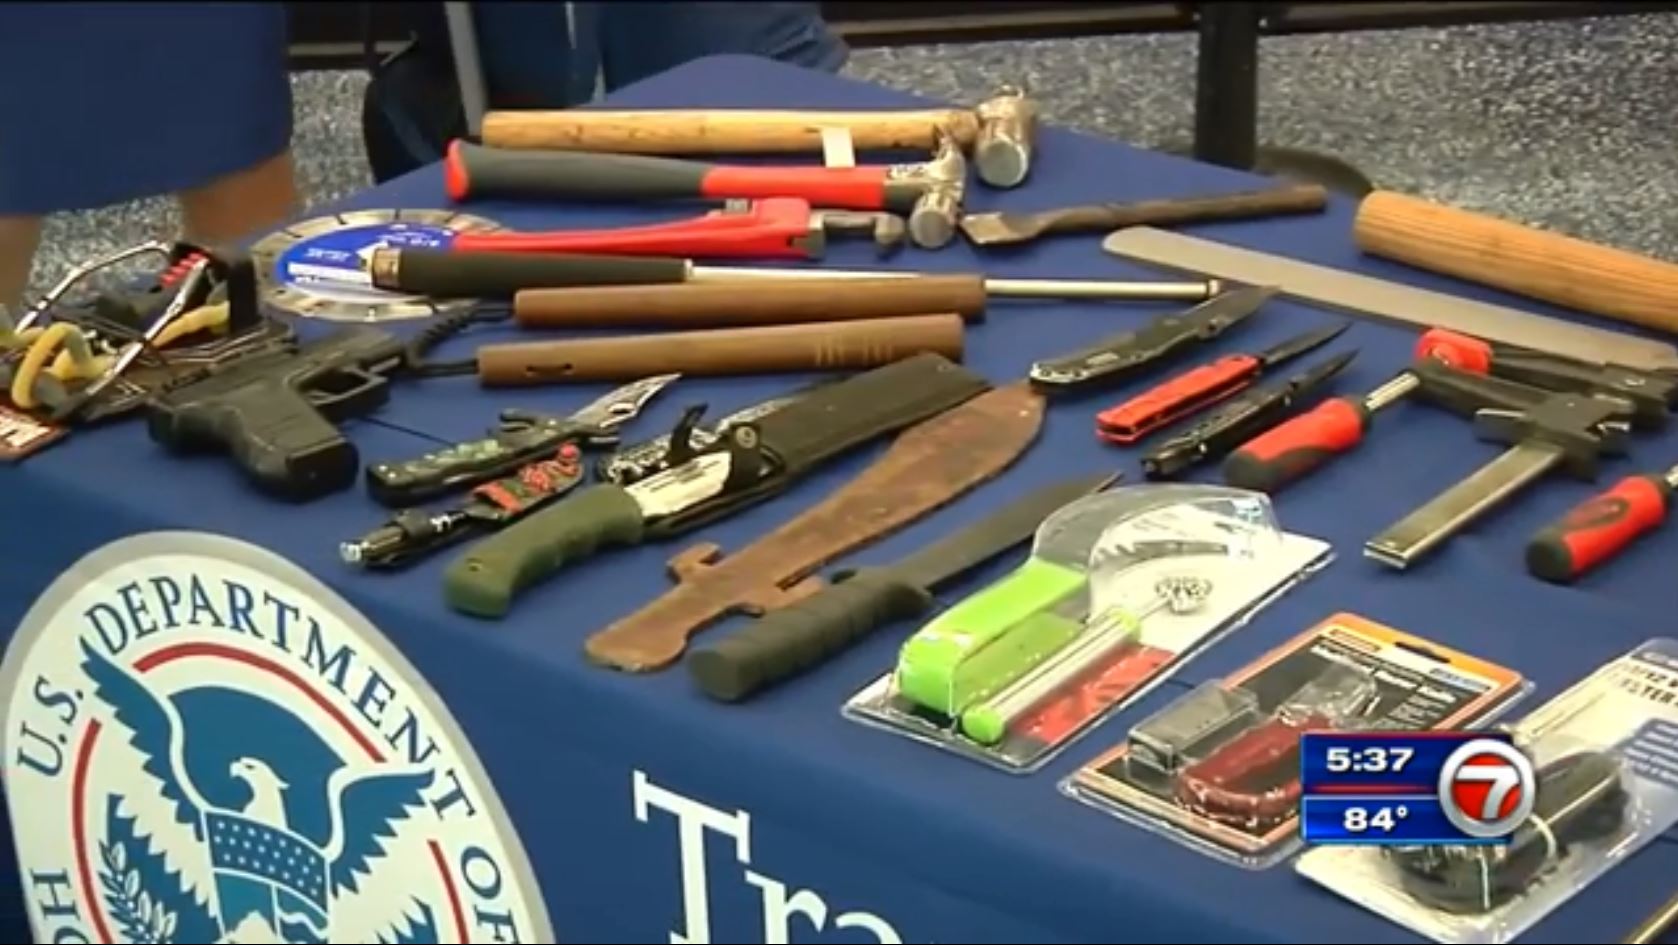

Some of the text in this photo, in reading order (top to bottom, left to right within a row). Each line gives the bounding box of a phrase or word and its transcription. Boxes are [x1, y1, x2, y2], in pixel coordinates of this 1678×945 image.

[17, 573, 521, 944] U.S. DEPARTMENT OF
